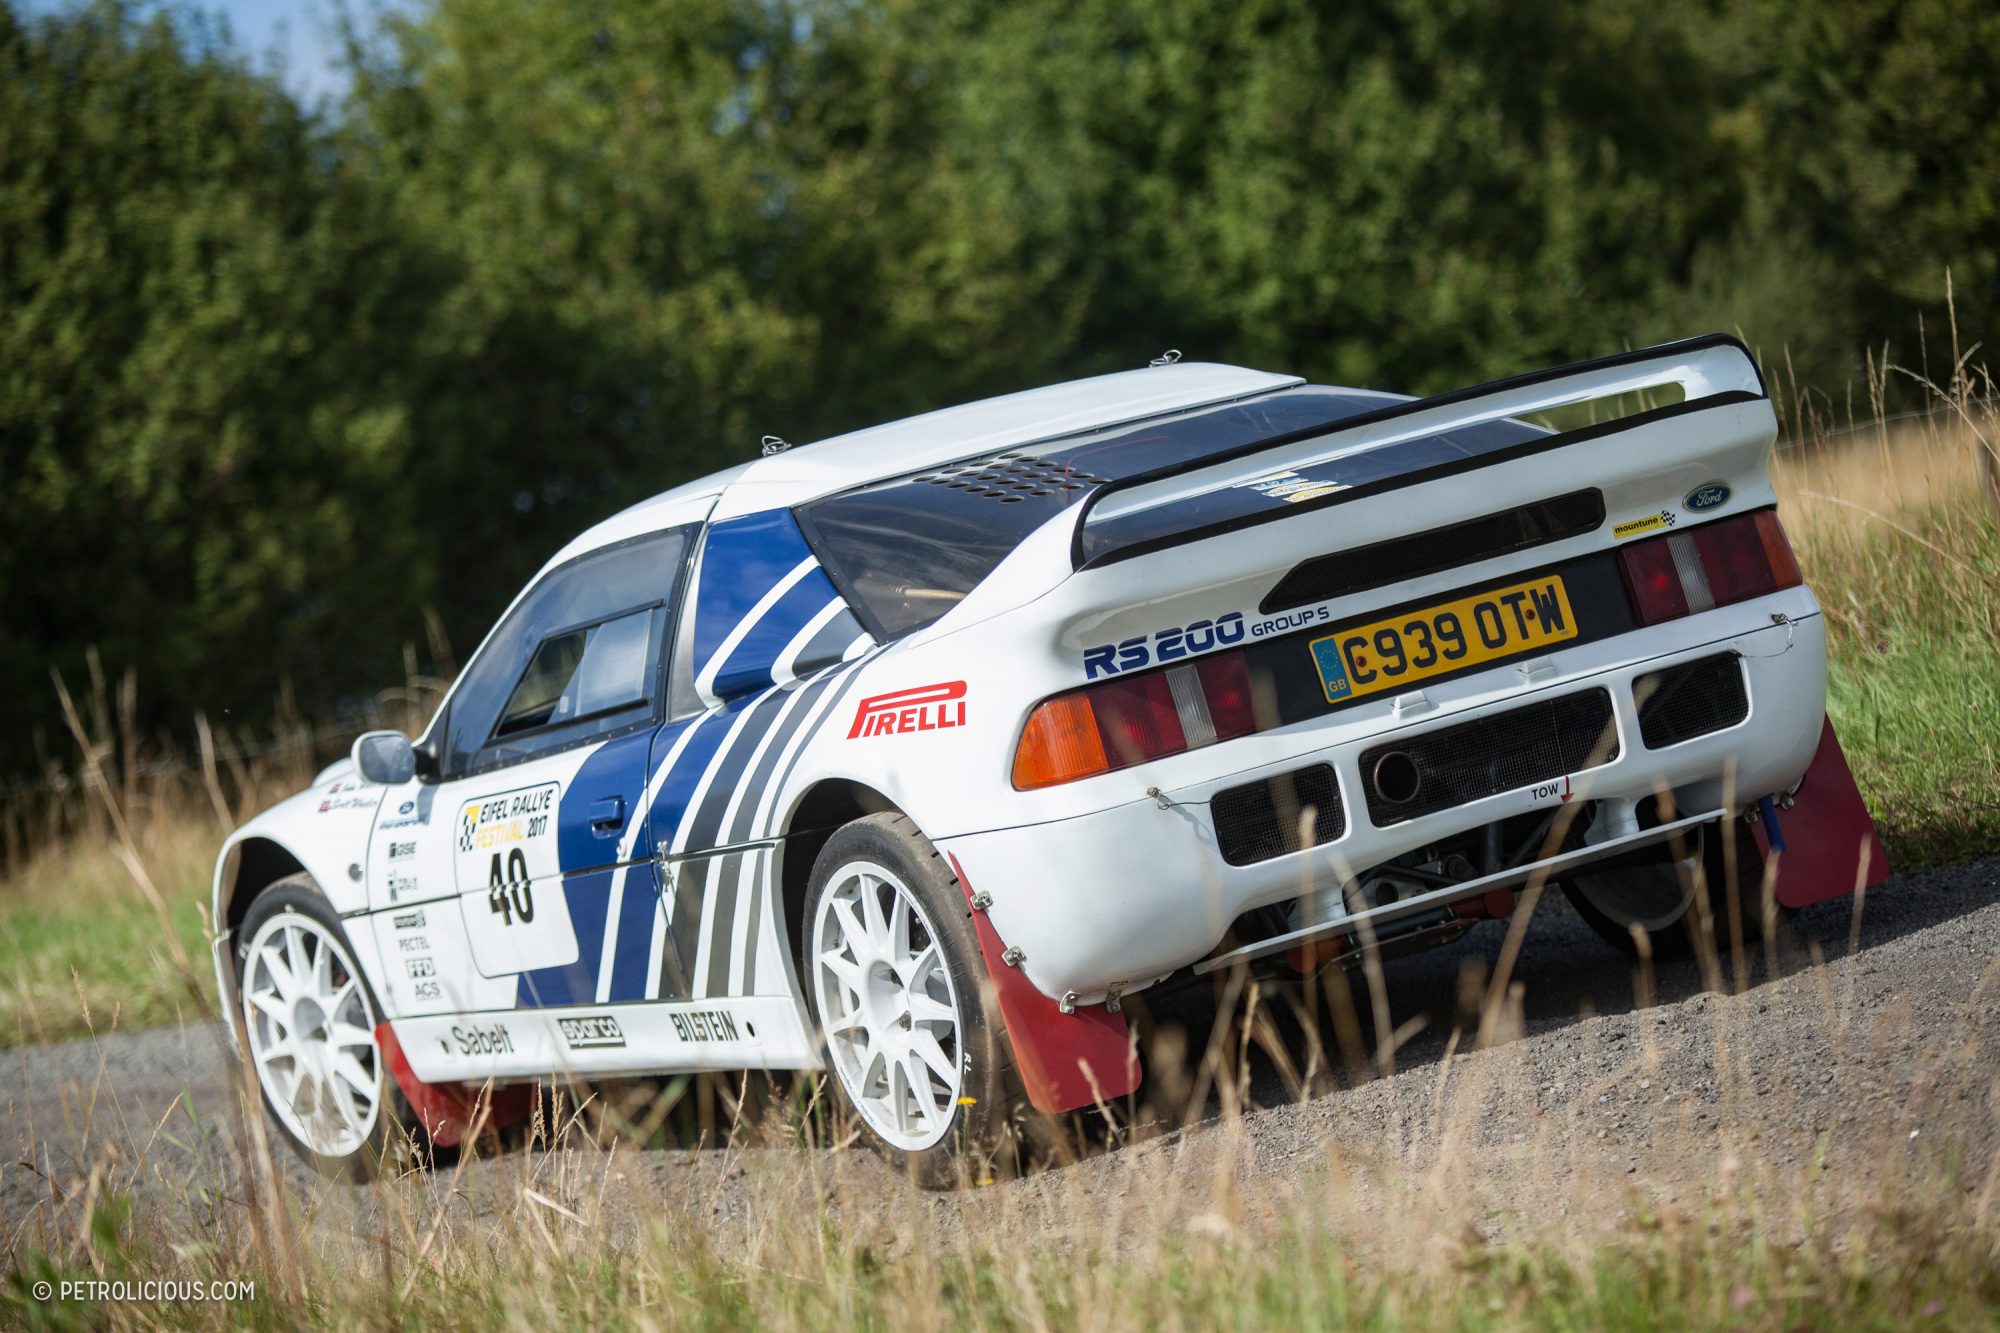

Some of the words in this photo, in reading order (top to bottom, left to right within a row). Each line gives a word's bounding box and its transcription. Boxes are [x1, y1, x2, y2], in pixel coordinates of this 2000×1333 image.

[1696, 489, 1722, 507] Ford
[1614, 517, 1659, 534] mountune
[1251, 611, 1315, 636] GROUP
[1317, 606, 1330, 619] S
[1342, 612, 1468, 685] C939
[1473, 584, 1566, 650] OTW
[1328, 679, 1347, 694] GB
[846, 680, 967, 740] PIRELLI
[1531, 783, 1558, 800] TOW
[480, 800, 508, 823] EIFEL
[511, 789, 554, 817] RALLYE
[476, 821, 523, 848] FESTIVAL
[527, 815, 548, 838] 2017
[489, 848, 534, 927] 40
[415, 982, 441, 998] ACS
[452, 1024, 514, 1056] Sabelt
[561, 1018, 621, 1046] sparco
[669, 1010, 740, 1042] BILSTEIN
